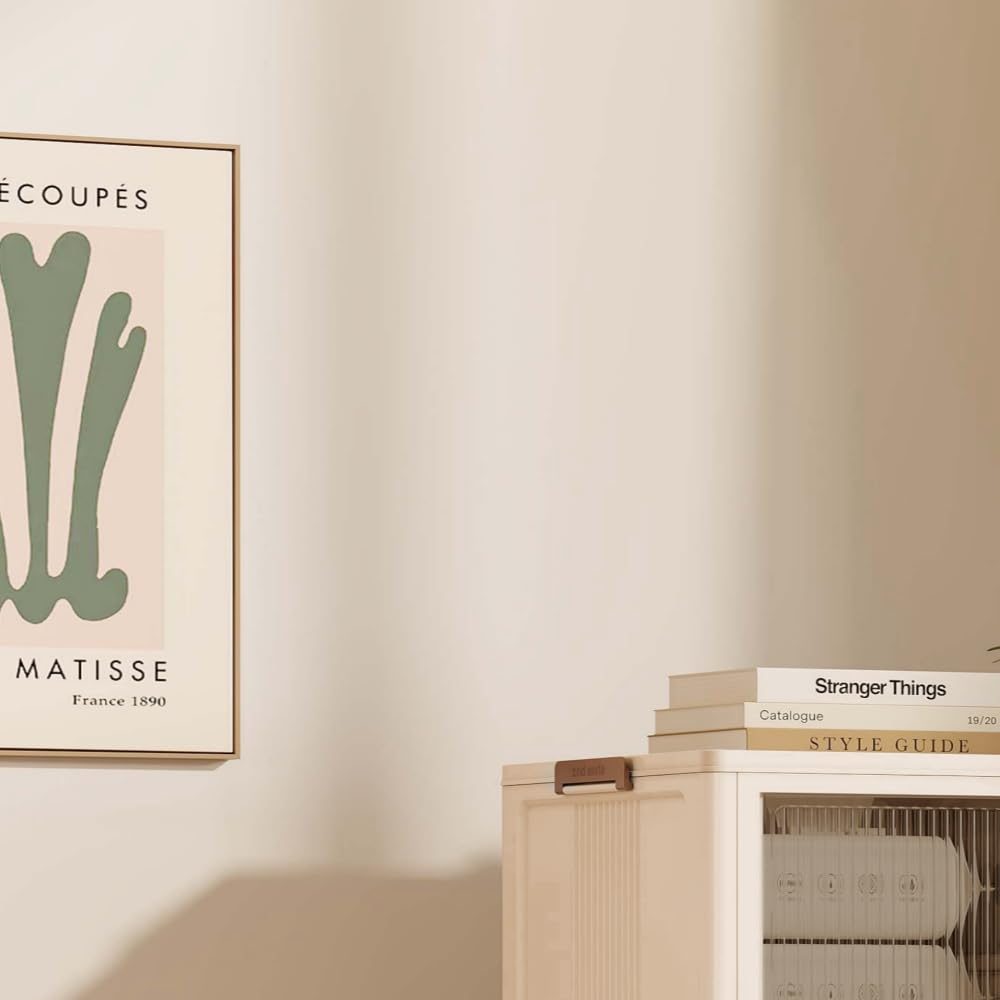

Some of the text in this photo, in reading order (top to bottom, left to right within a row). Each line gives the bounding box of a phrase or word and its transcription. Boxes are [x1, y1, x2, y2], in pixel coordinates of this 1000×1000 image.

[0, 177, 148, 210] ÉCOUPÉS
[16, 658, 167, 682] MATISSE
[815, 677, 947, 700] Stranger Things
[72, 694, 167, 707] France 1890
[760, 709, 997, 725] Catalogue 19/20
[809, 736, 970, 753] STYLE GUIDE
